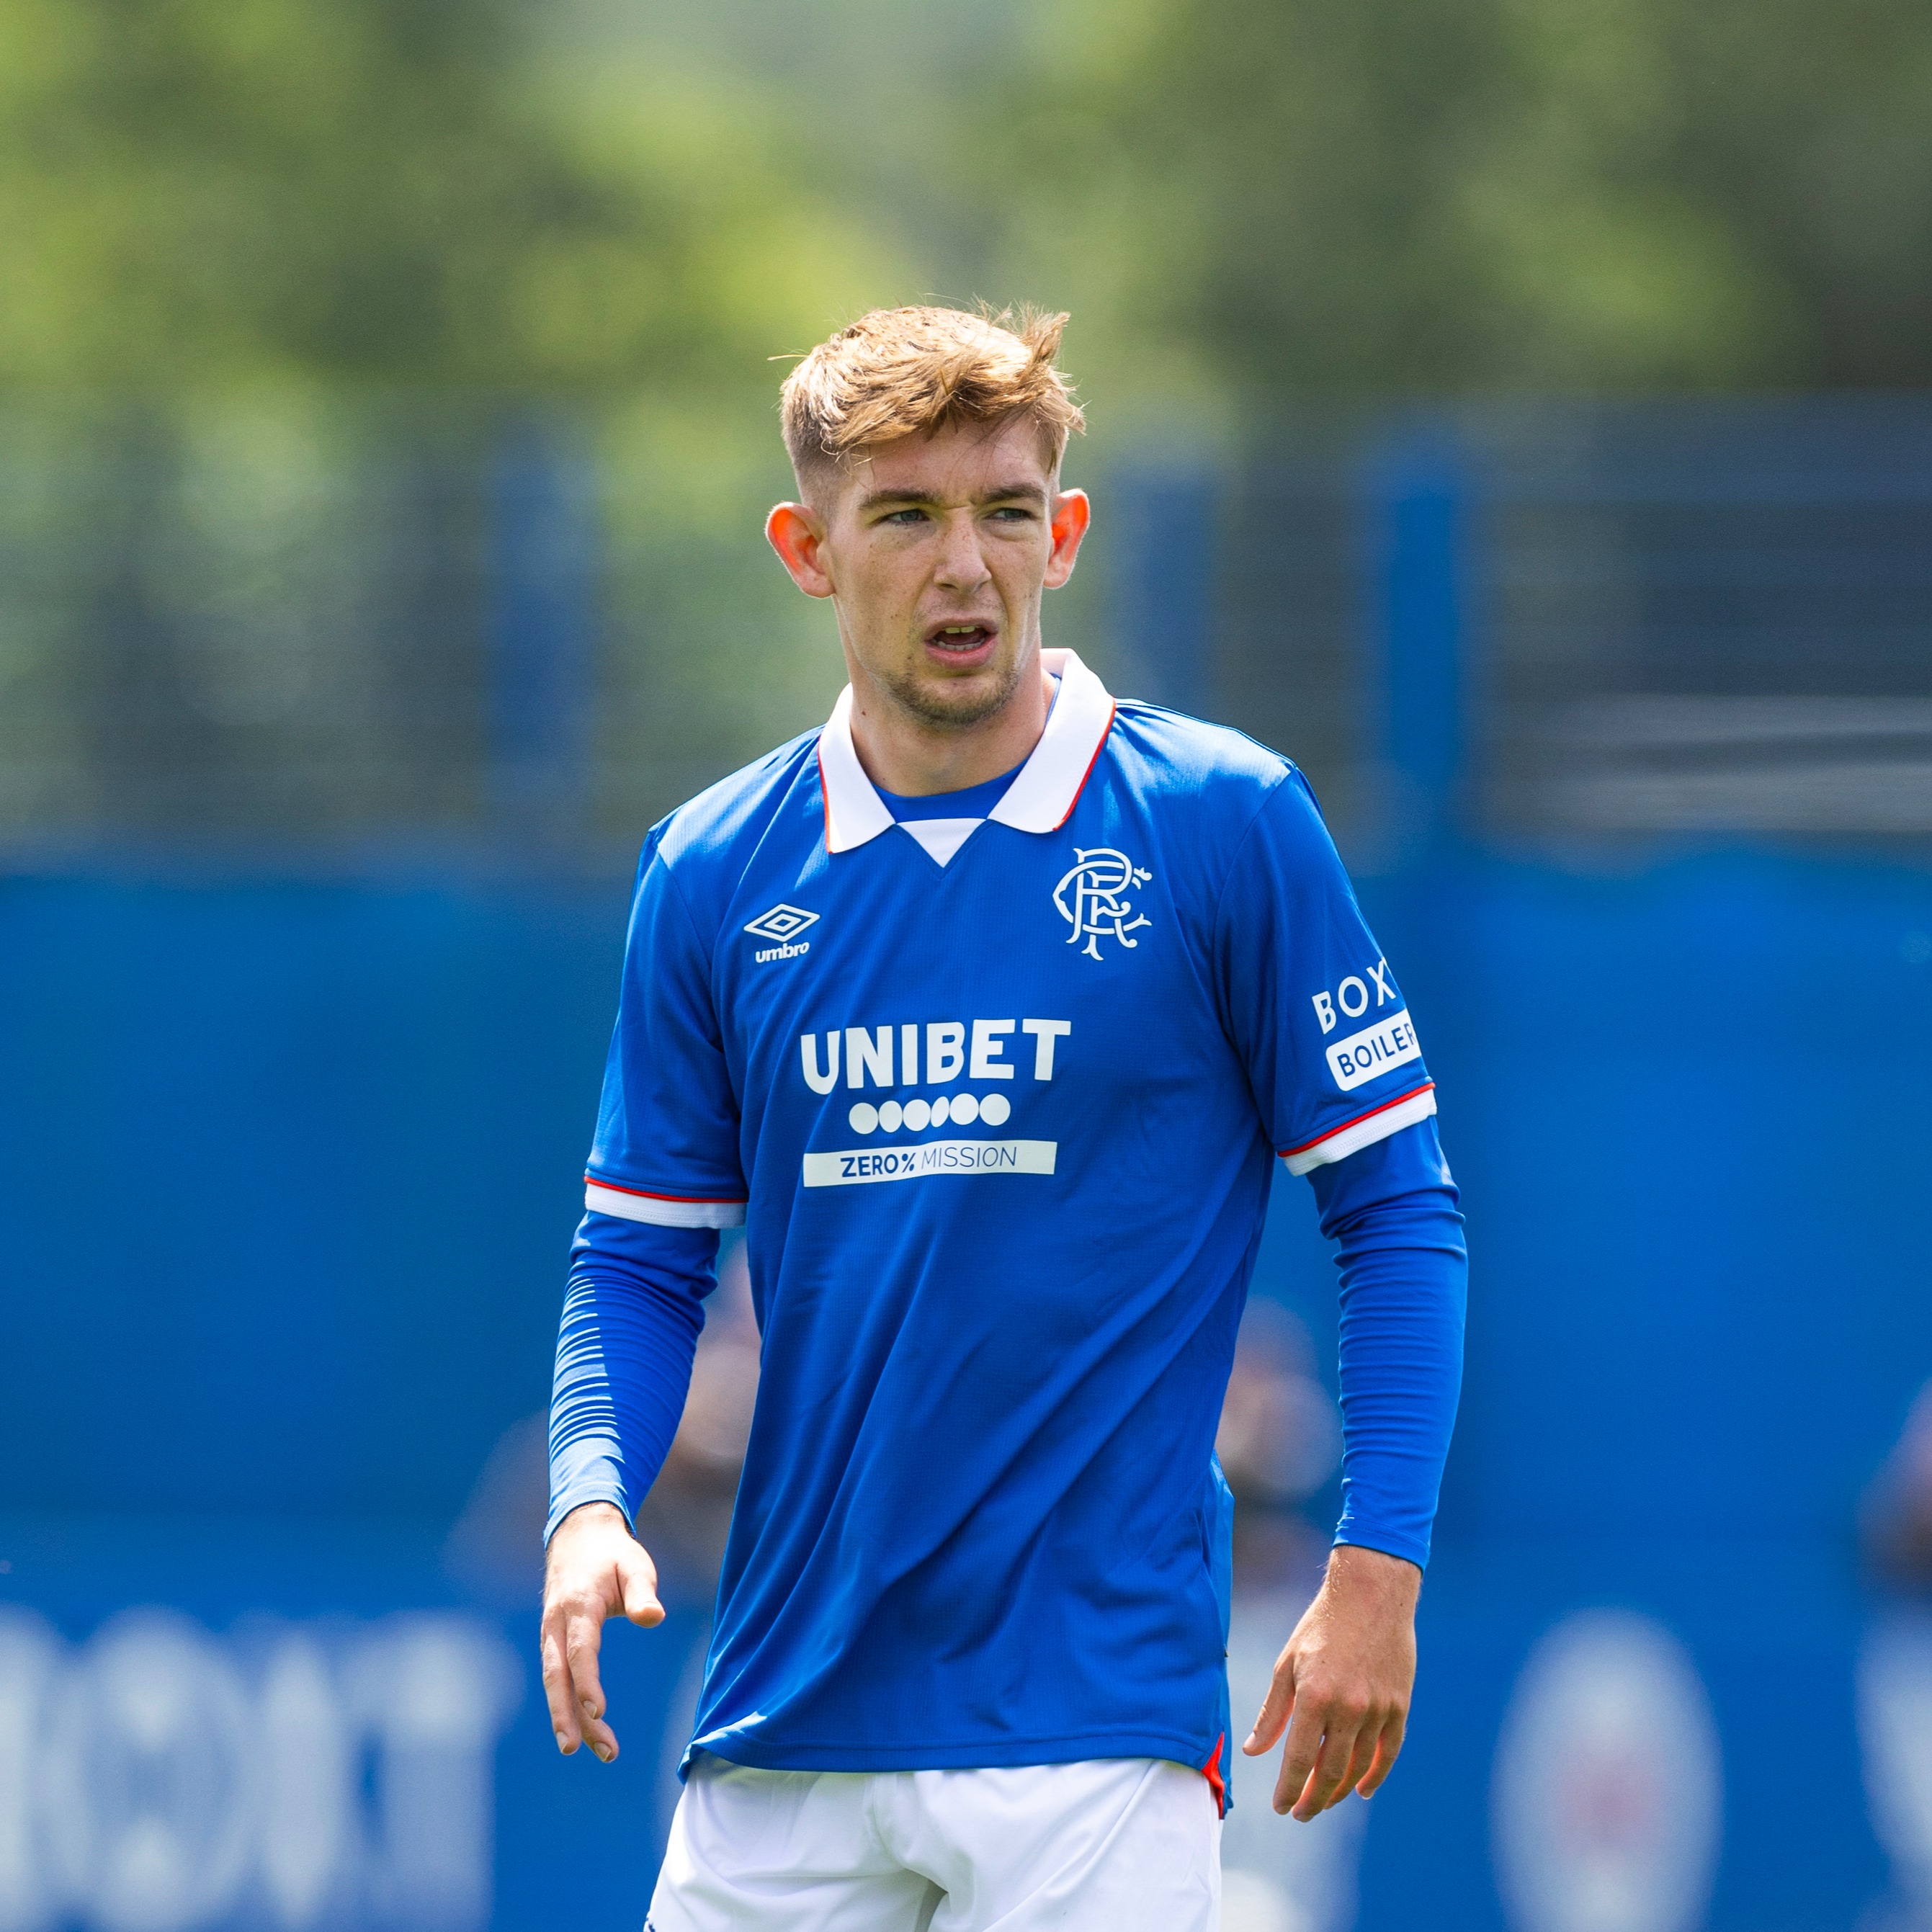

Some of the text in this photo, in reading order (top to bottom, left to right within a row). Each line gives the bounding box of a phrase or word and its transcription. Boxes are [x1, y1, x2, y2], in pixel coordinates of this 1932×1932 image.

[755, 942, 810, 963] umbro
[1312, 957, 1397, 1034] BOX
[800, 1019, 1072, 1095] UNIBET
[840, 1147, 1017, 1178] ZERO% MISSION
